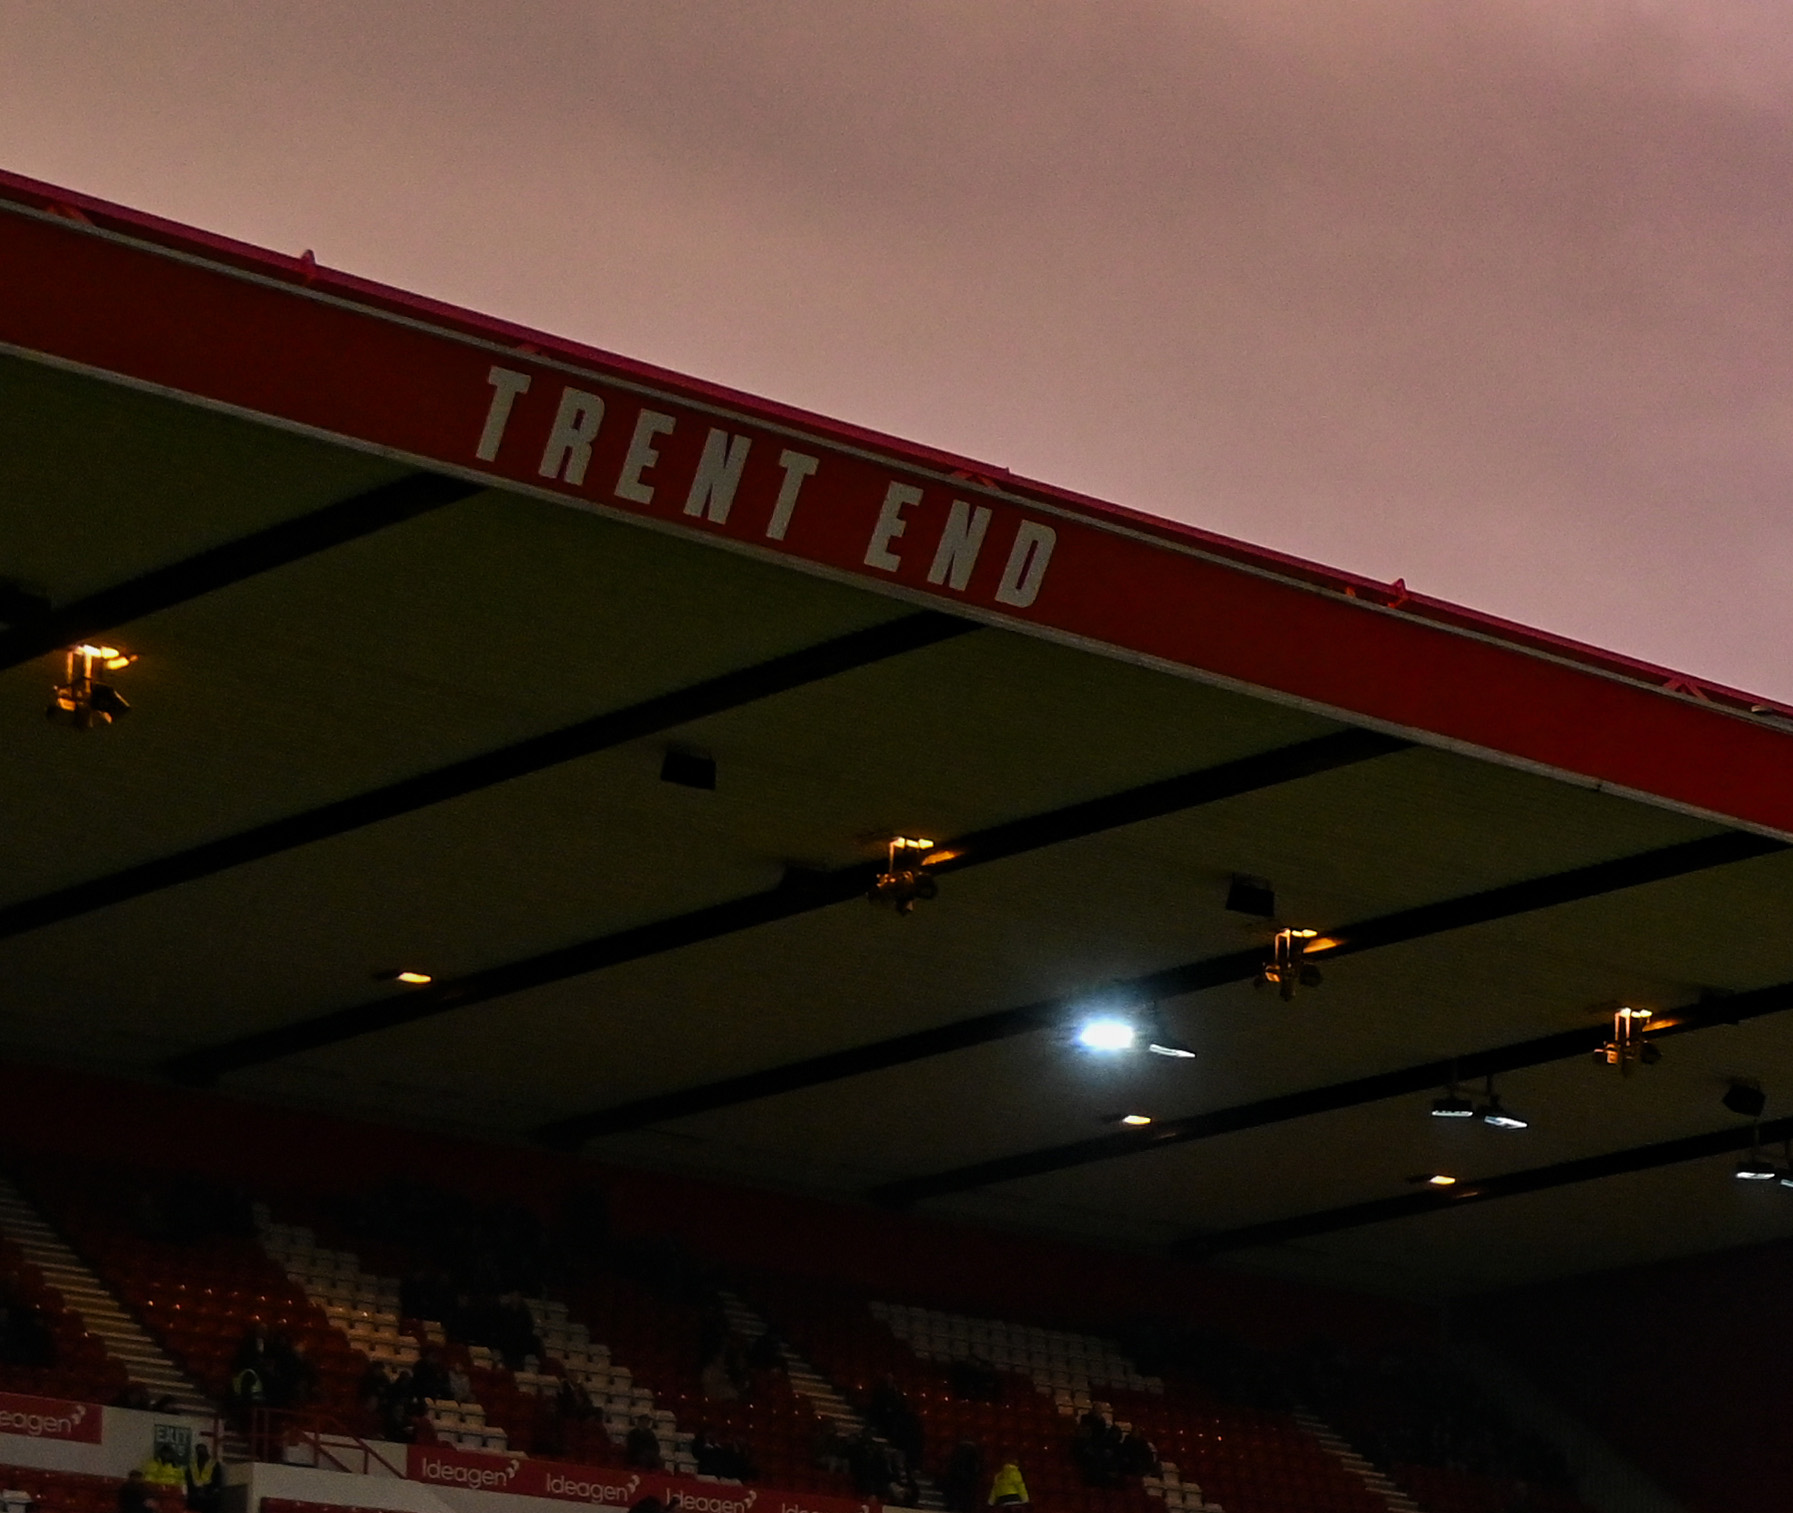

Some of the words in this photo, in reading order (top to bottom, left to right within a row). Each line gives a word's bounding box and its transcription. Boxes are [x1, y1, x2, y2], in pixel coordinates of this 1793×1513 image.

[475, 366, 819, 541] TRENT
[864, 480, 1056, 609] END
[422, 1457, 507, 1489] Ideagen
[546, 1472, 628, 1502] Ideagen
